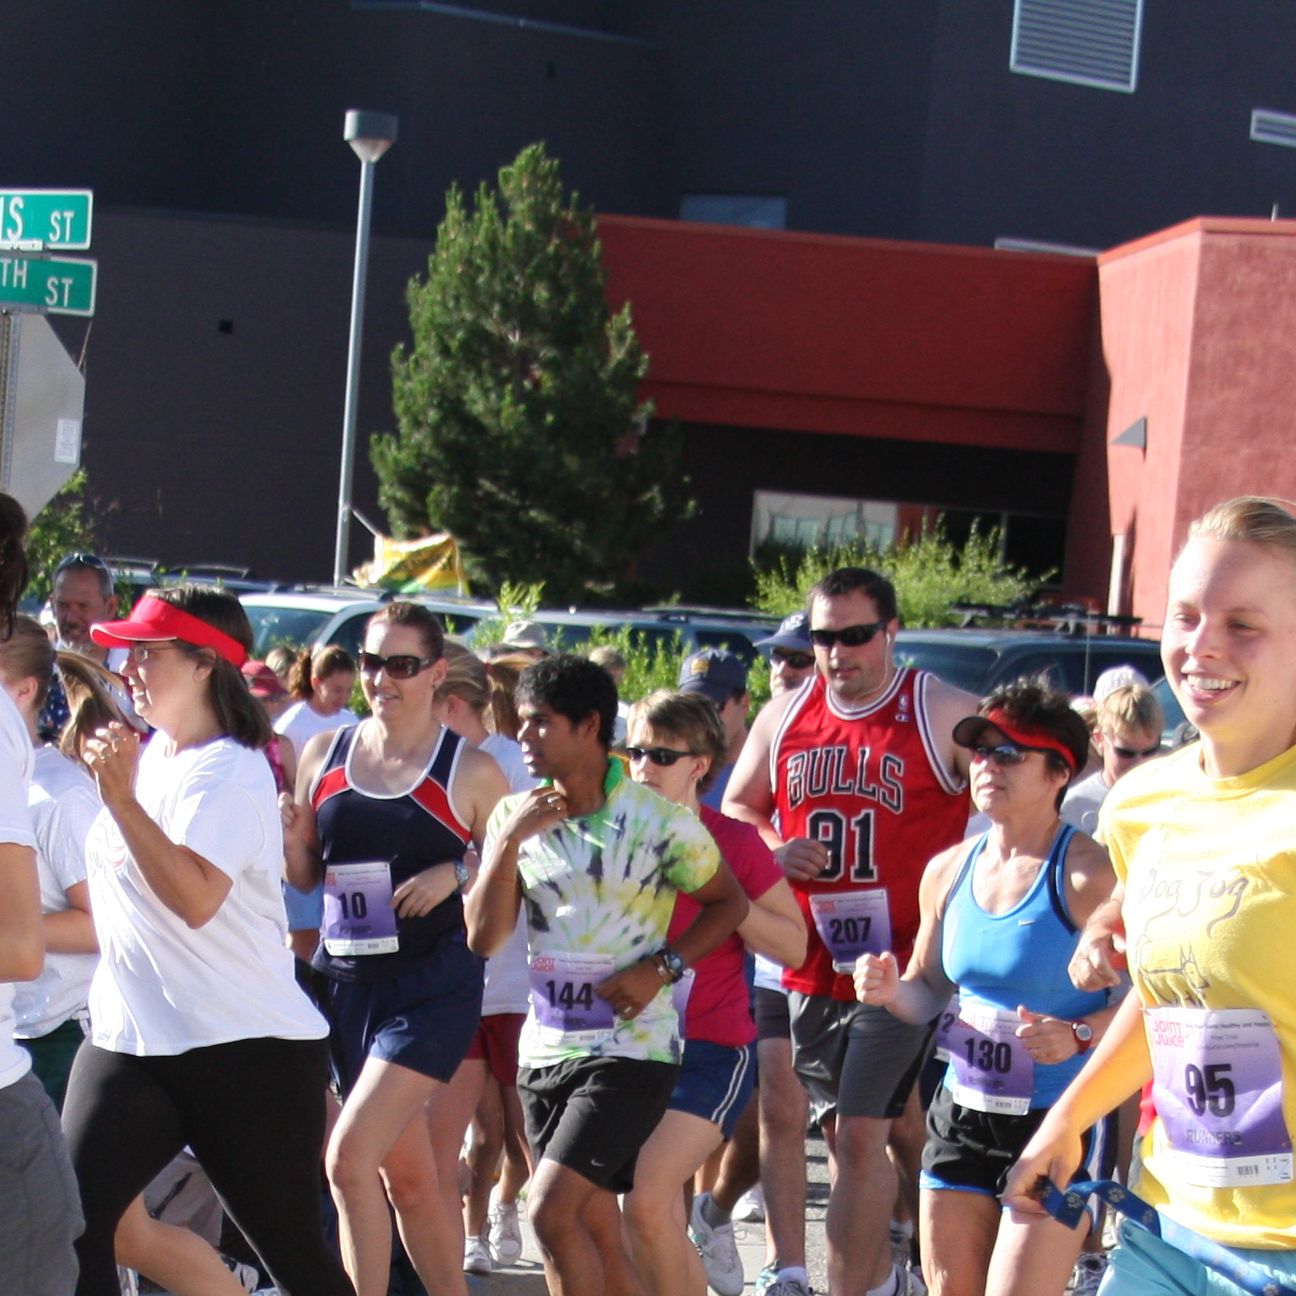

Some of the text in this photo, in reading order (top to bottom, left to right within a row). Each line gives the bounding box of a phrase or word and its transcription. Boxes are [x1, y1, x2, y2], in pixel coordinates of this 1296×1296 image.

[49, 210, 75, 243] ST
[45, 277, 74, 308] ST
[787, 746, 904, 815] BULLS
[807, 809, 878, 882] 91
[338, 892, 367, 919] 10
[829, 916, 872, 945] 207
[546, 980, 593, 1011] 144
[965, 1038, 1012, 1074] 130
[1185, 1063, 1235, 1117] 95
[1187, 1129, 1241, 1146] RUNNERS
